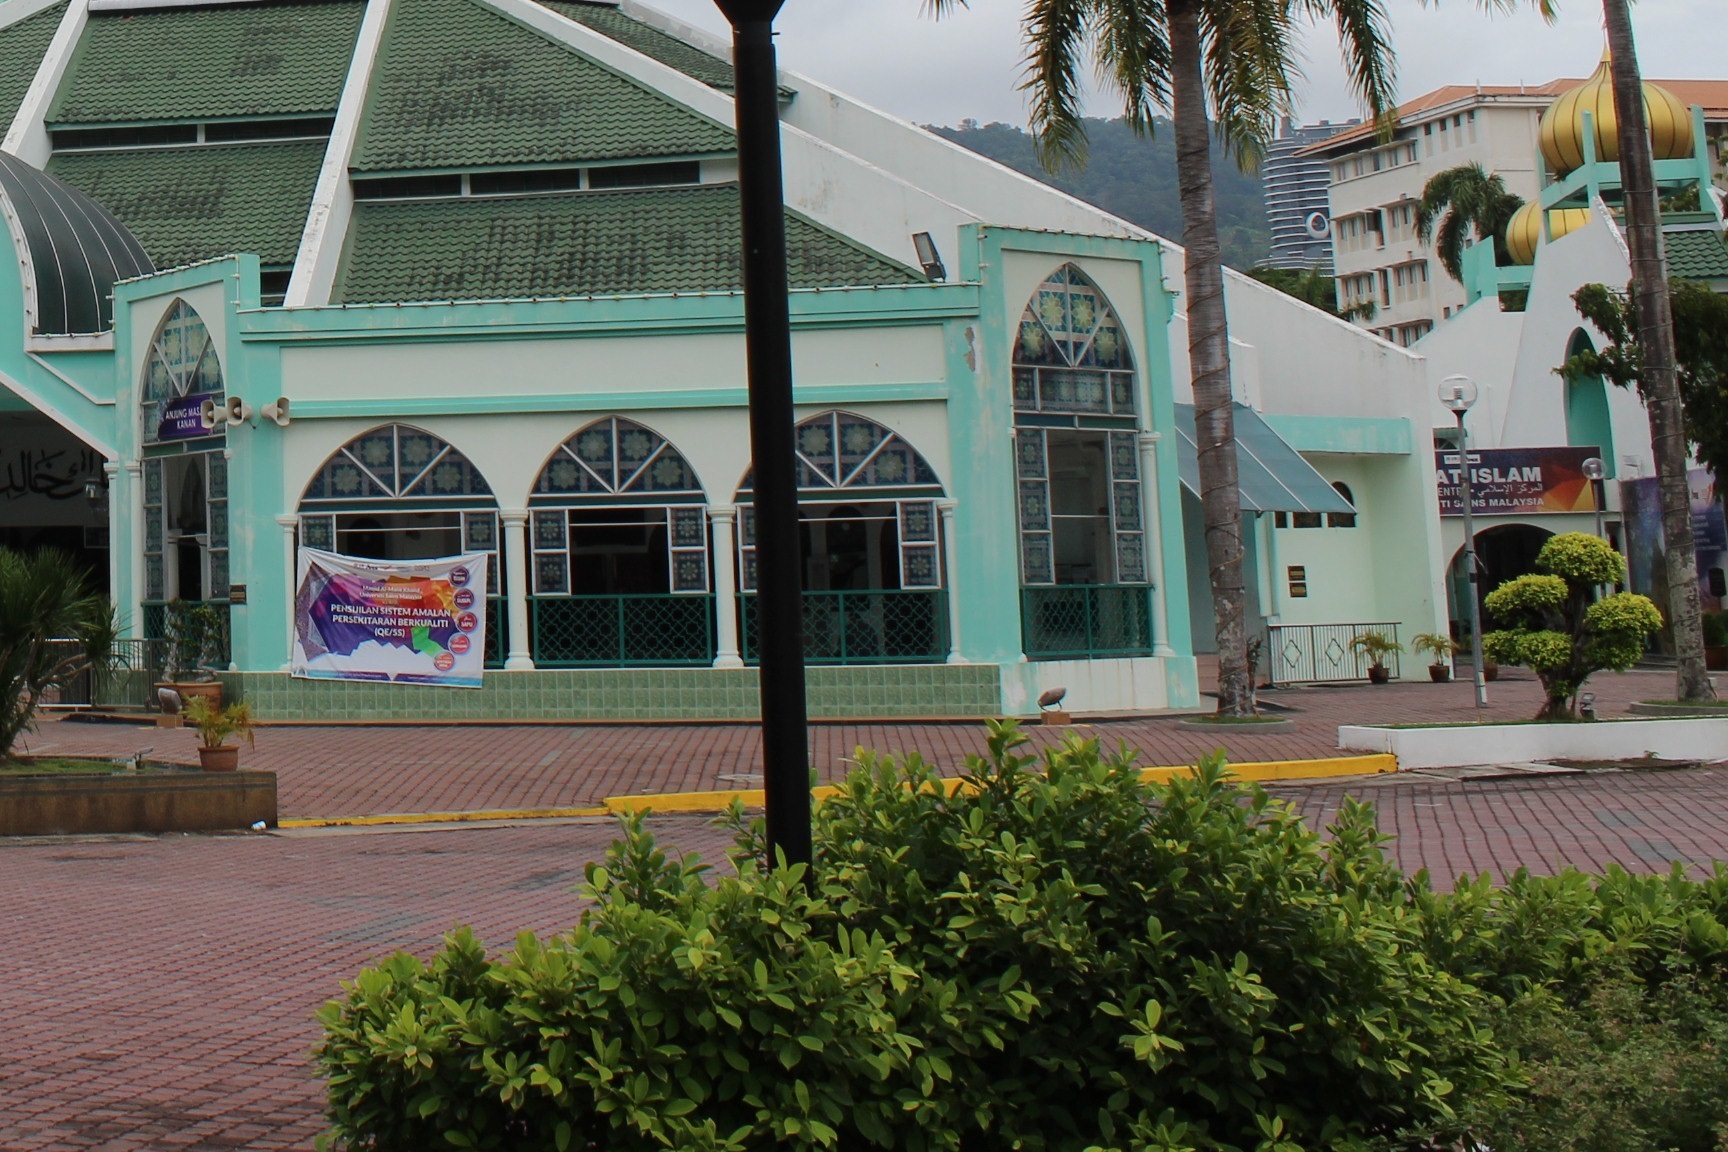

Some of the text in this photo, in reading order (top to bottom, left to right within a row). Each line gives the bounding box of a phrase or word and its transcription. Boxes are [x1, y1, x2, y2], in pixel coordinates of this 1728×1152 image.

[165, 406, 202, 420] ANJUNG MAS
[176, 419, 196, 429] KANAN
[1471, 466, 1542, 484] ISLAM
[1489, 497, 1544, 507] MALAYSIA
[380, 606, 411, 616] SISTEM
[412, 608, 451, 618] AMALAN
[332, 614, 449, 628] PERSEKITARAN BERKUALITI
